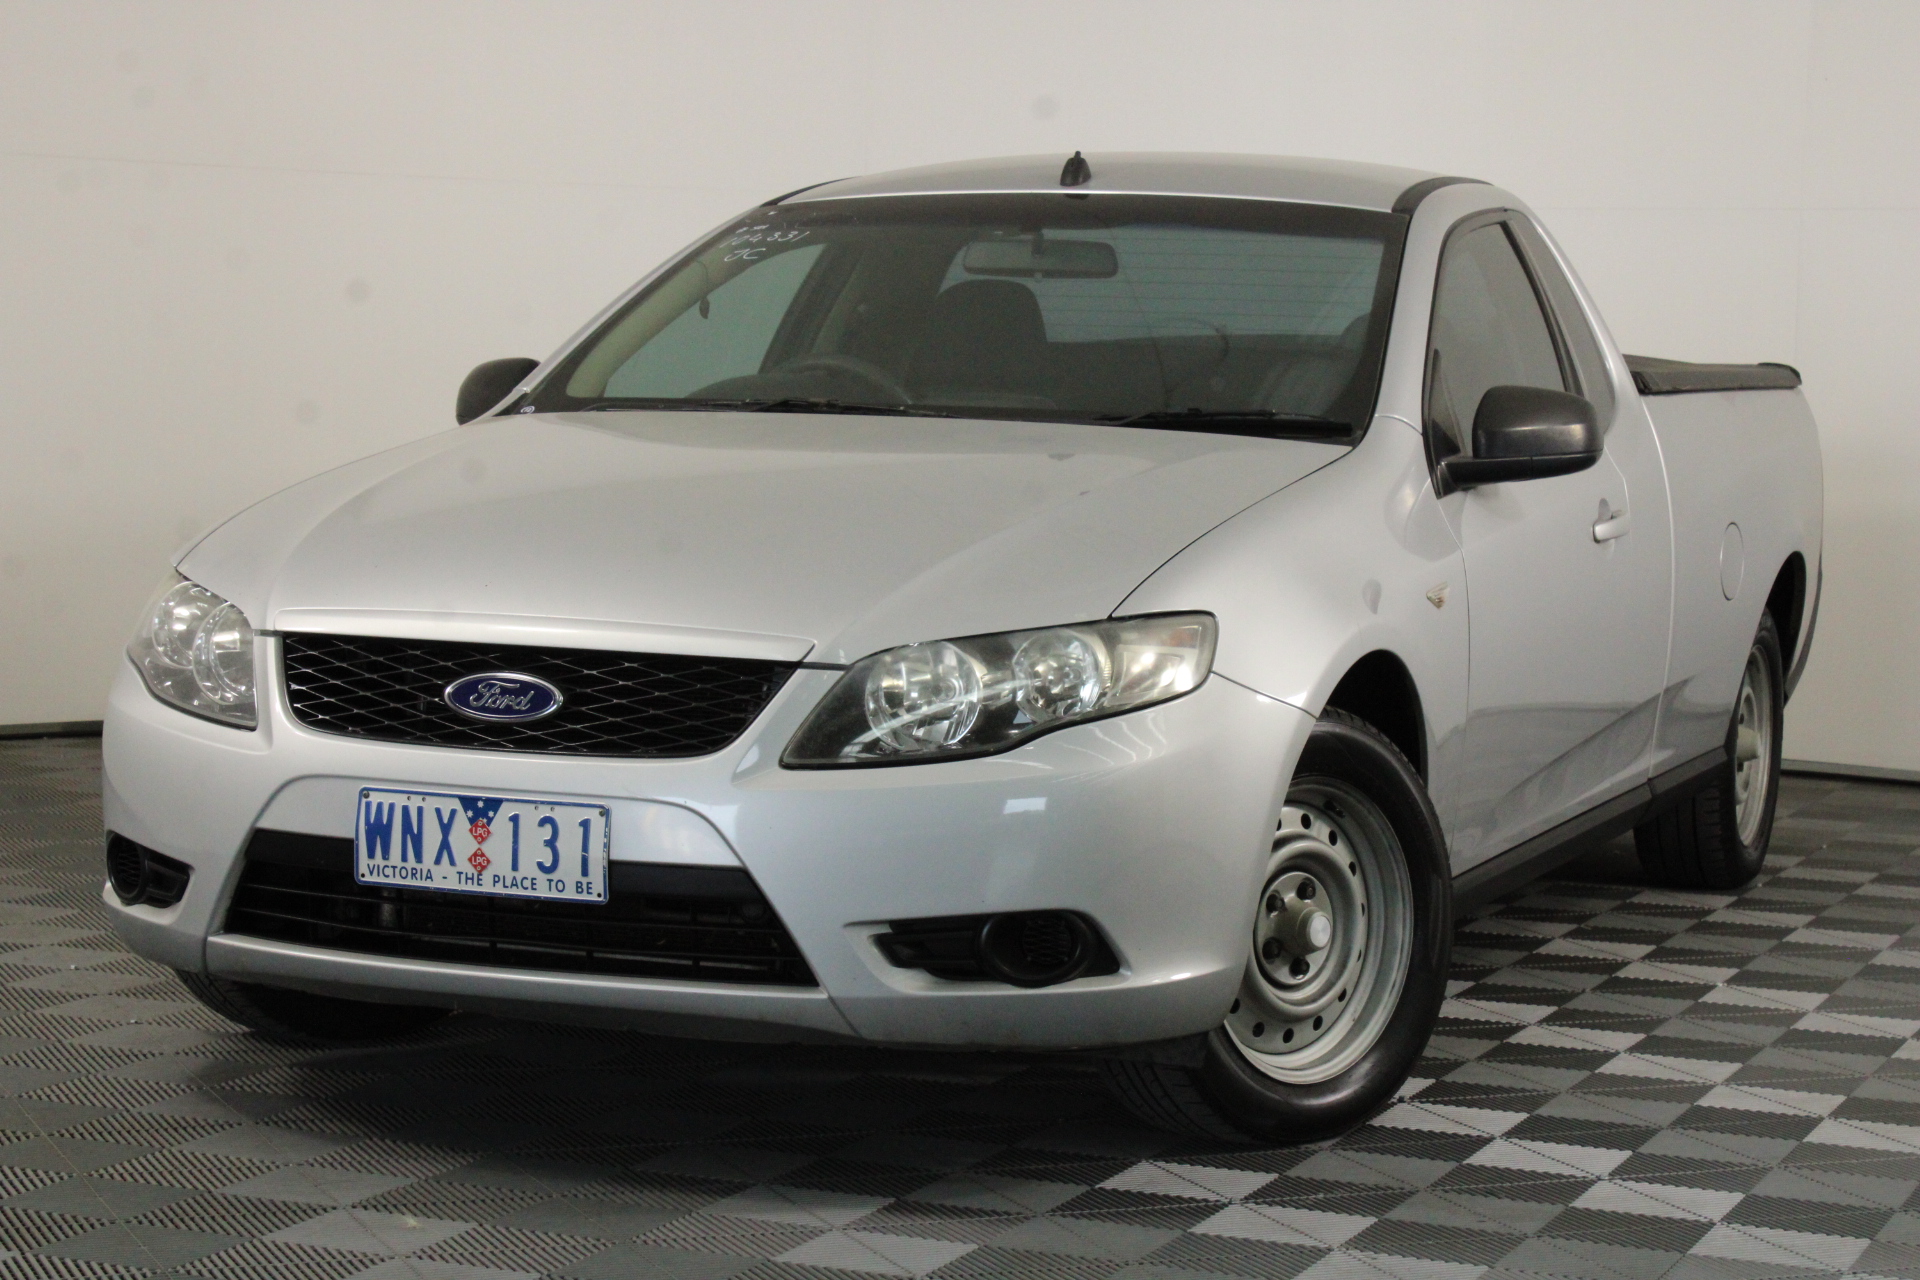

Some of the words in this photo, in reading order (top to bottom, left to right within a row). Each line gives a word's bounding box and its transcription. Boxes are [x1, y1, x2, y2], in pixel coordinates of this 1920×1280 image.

[469, 680, 535, 711] Ford
[364, 800, 459, 867] WNX
[507, 811, 592, 878] 131
[472, 826, 489, 838] LPG
[471, 855, 488, 866] LPG
[366, 863, 434, 882] VICTORIA
[456, 871, 484, 887] THE
[492, 874, 538, 891] PLACE
[546, 878, 566, 893] TO
[575, 880, 594, 895] BE
